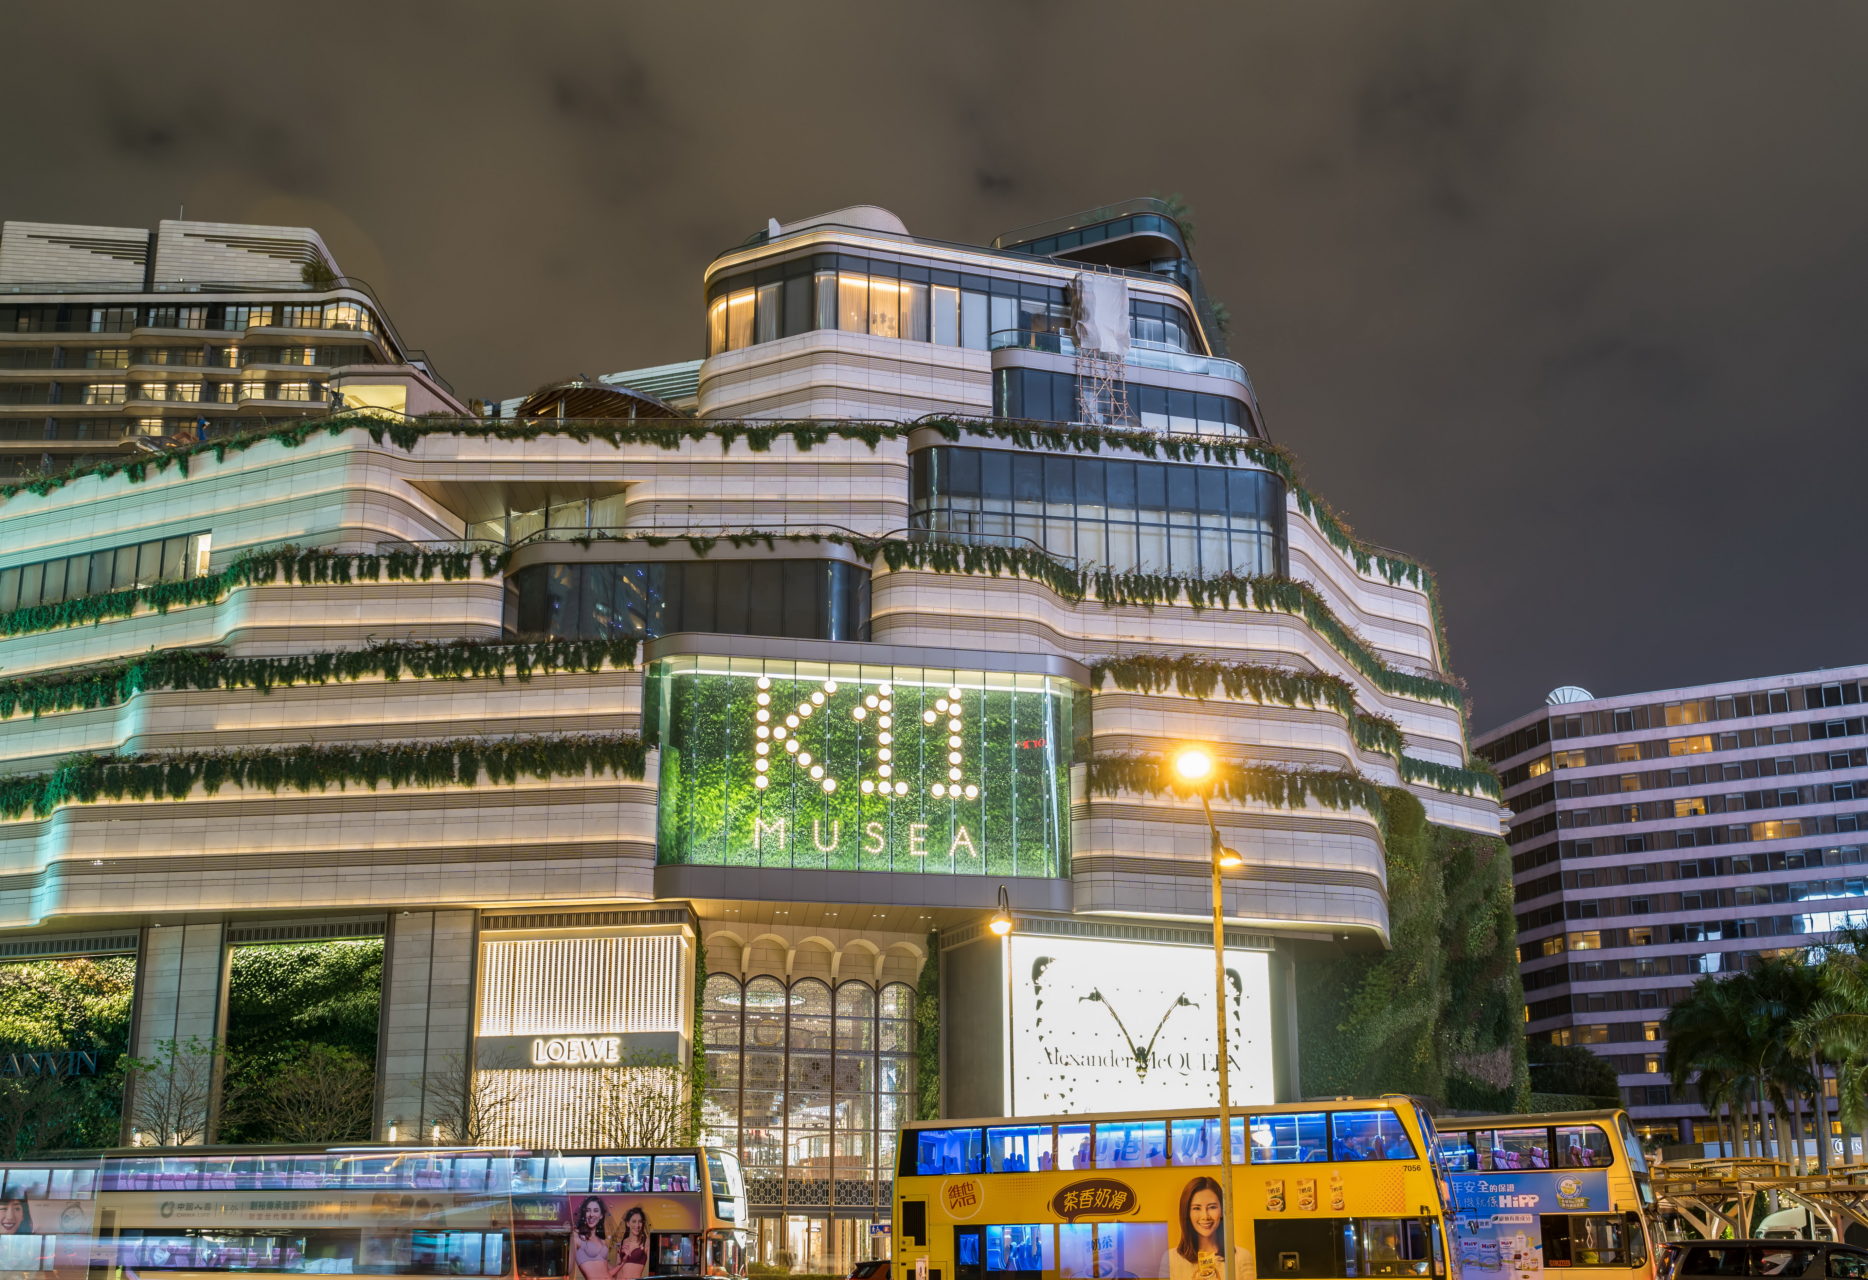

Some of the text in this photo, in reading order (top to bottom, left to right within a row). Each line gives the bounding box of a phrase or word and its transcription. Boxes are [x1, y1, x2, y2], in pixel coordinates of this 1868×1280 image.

[755, 676, 980, 800] K11
[754, 817, 977, 859] MUSEA
[534, 1039, 619, 1062] LOEWE
[1042, 1046, 1132, 1068] Alexander
[947, 1181, 974, 1199] 維他
[1063, 1188, 1128, 1212] 茶香奶滑
